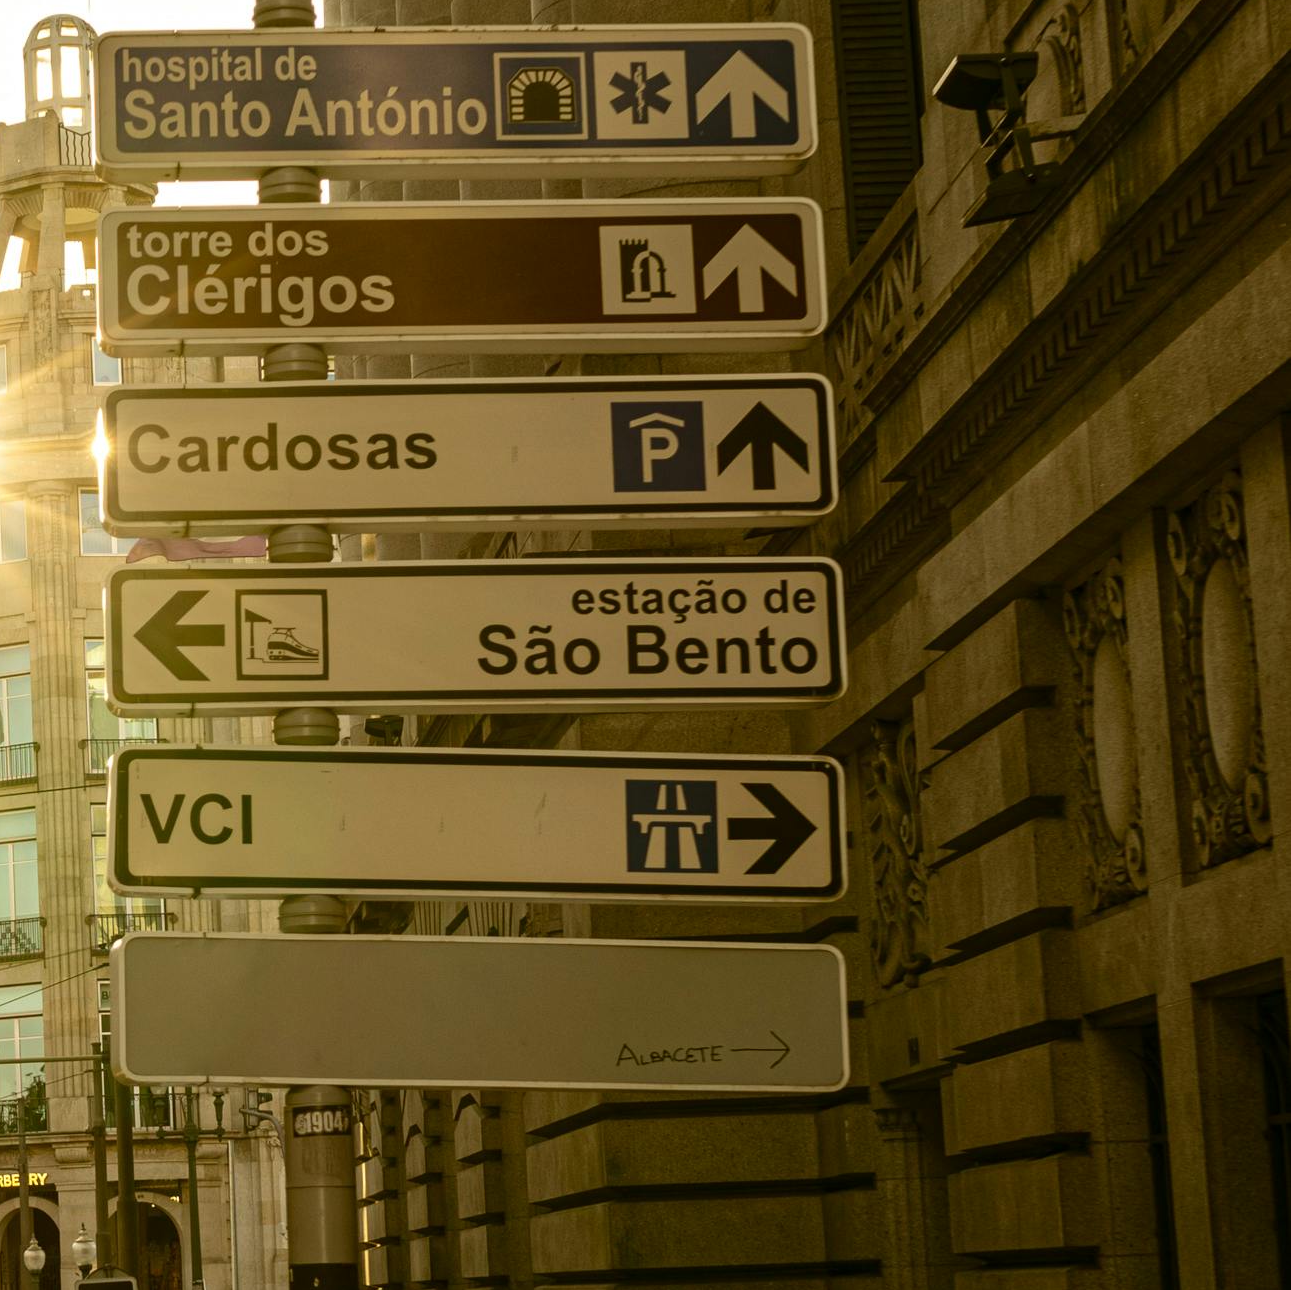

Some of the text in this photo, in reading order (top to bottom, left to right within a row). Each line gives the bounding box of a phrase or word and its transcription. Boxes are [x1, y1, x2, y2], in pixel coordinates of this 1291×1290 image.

[122, 47, 317, 90] hospital de
[124, 86, 487, 139] Santo António
[126, 222, 329, 258] torre dos
[126, 263, 395, 327] Clérigos
[127, 422, 438, 474] Cardosas
[571, 579, 817, 623] estação de
[477, 624, 818, 675] São Bento
[139, 793, 253, 845] VCI
